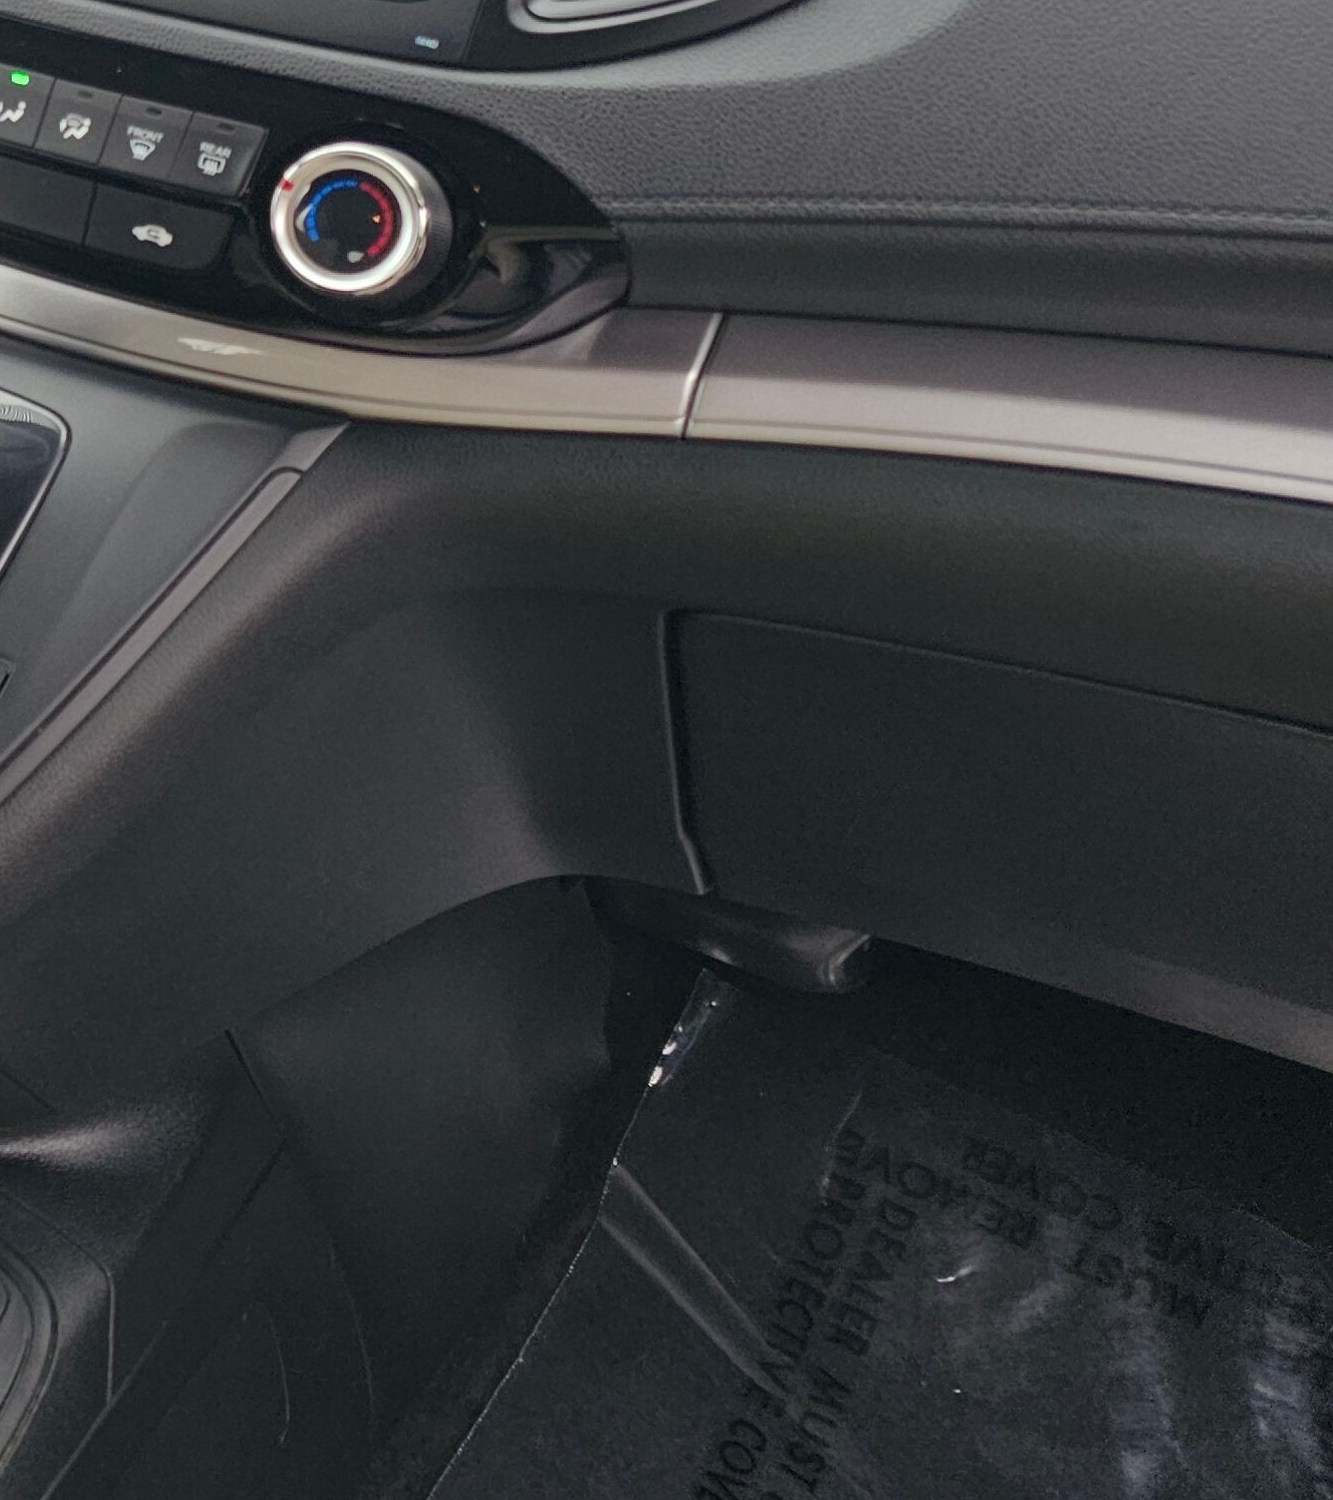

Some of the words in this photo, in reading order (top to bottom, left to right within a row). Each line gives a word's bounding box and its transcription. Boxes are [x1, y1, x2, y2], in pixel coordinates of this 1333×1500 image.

[127, 126, 164, 144] FRONT
[199, 141, 232, 160] REAR
[693, 1419, 767, 1500] COV
